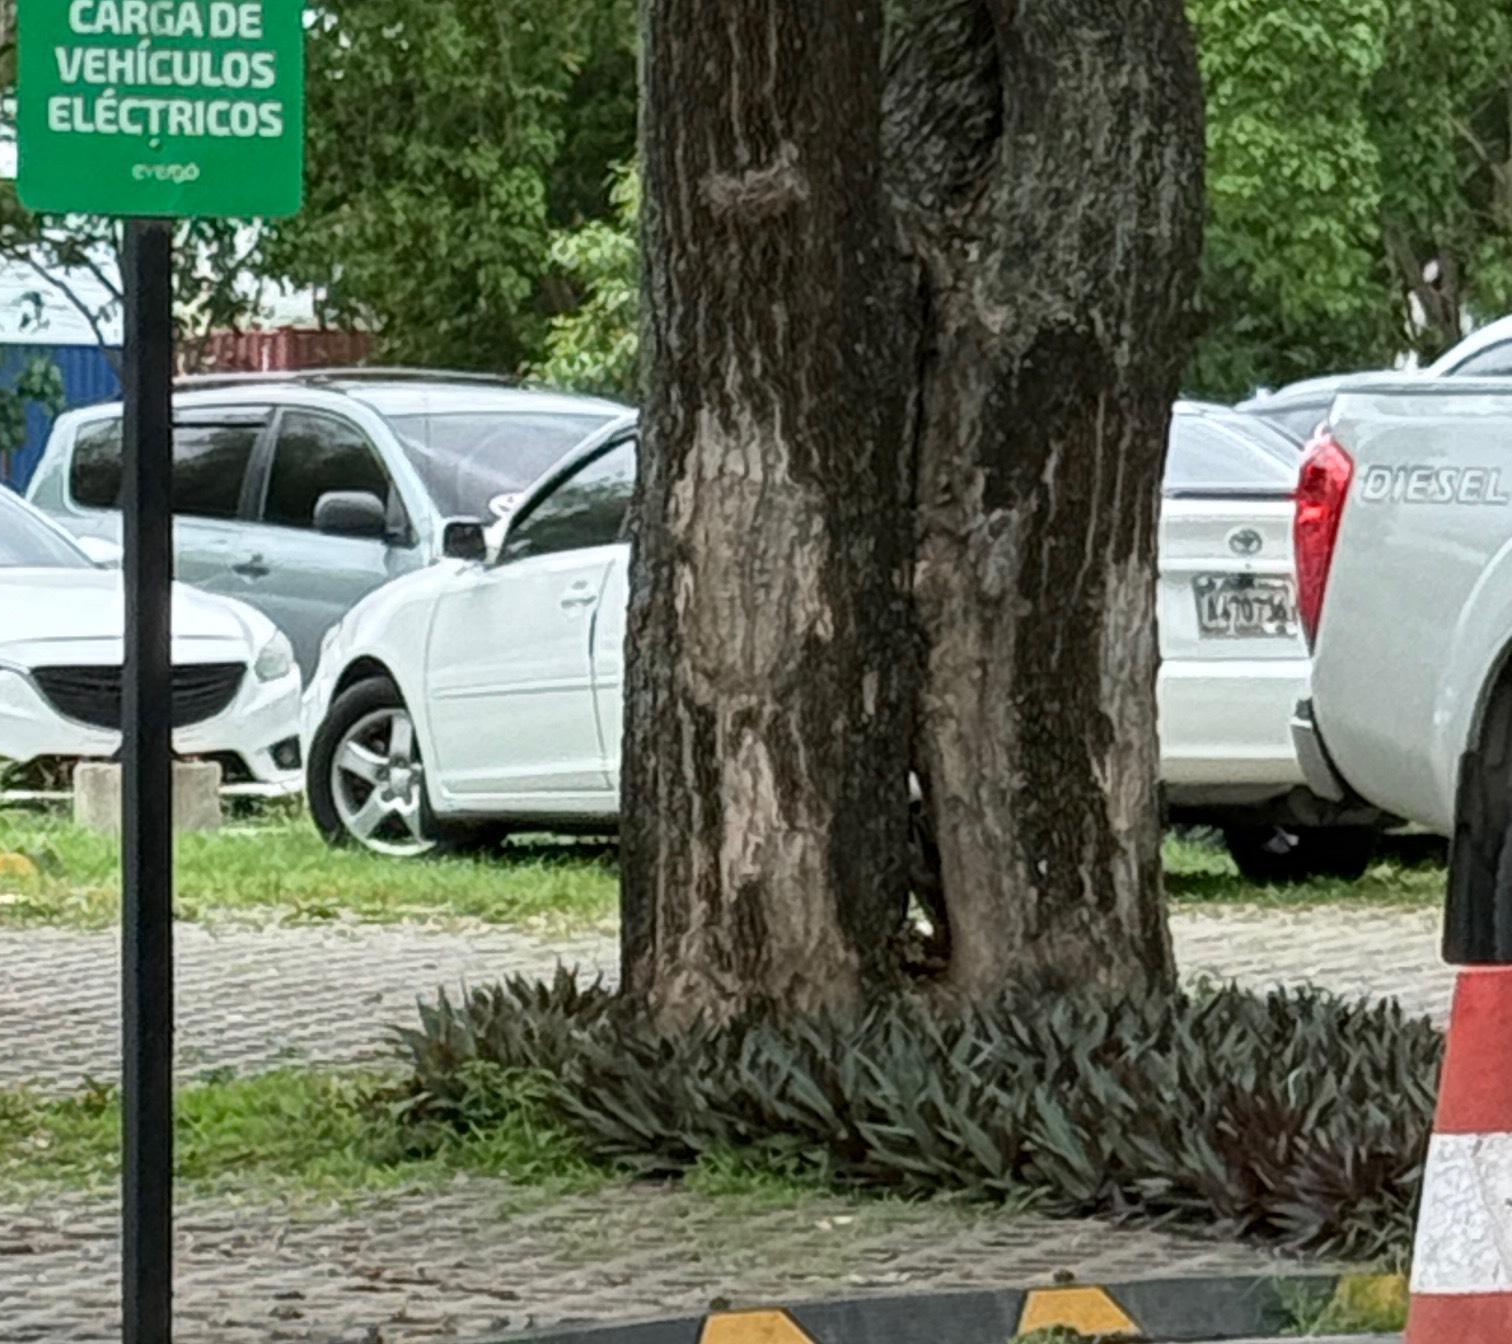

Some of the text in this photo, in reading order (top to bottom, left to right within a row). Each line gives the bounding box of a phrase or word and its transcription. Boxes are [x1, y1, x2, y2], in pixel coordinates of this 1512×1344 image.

[209, 2, 263, 40] DE
[54, 39, 276, 89] VEHÍCULOS
[47, 89, 283, 138] ELÉCTRICOS
[1361, 463, 1510, 506] DIESEL
